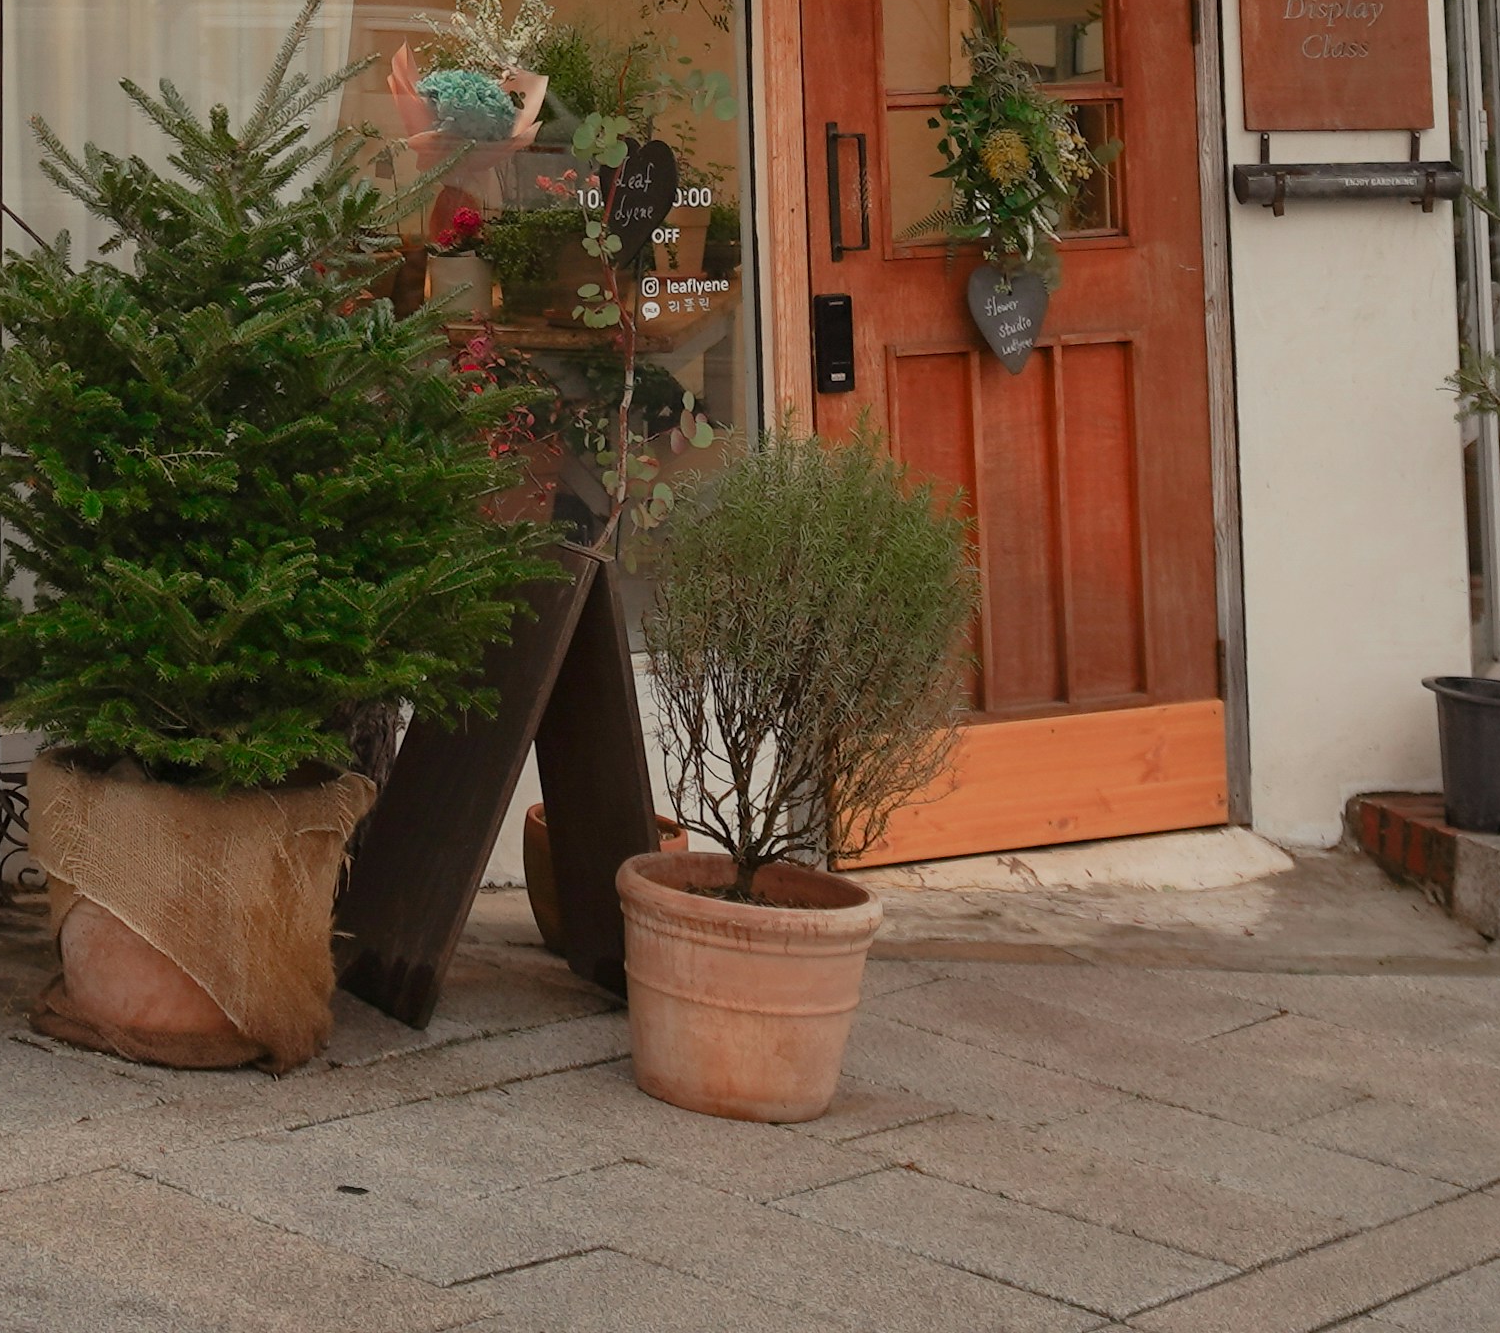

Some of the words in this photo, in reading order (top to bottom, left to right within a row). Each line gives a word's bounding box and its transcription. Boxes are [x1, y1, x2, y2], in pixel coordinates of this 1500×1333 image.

[1301, 33, 1370, 59] Class
[615, 155, 655, 193] Leaf
[651, 227, 681, 244] OFF
[666, 277, 729, 296] leaflyene
